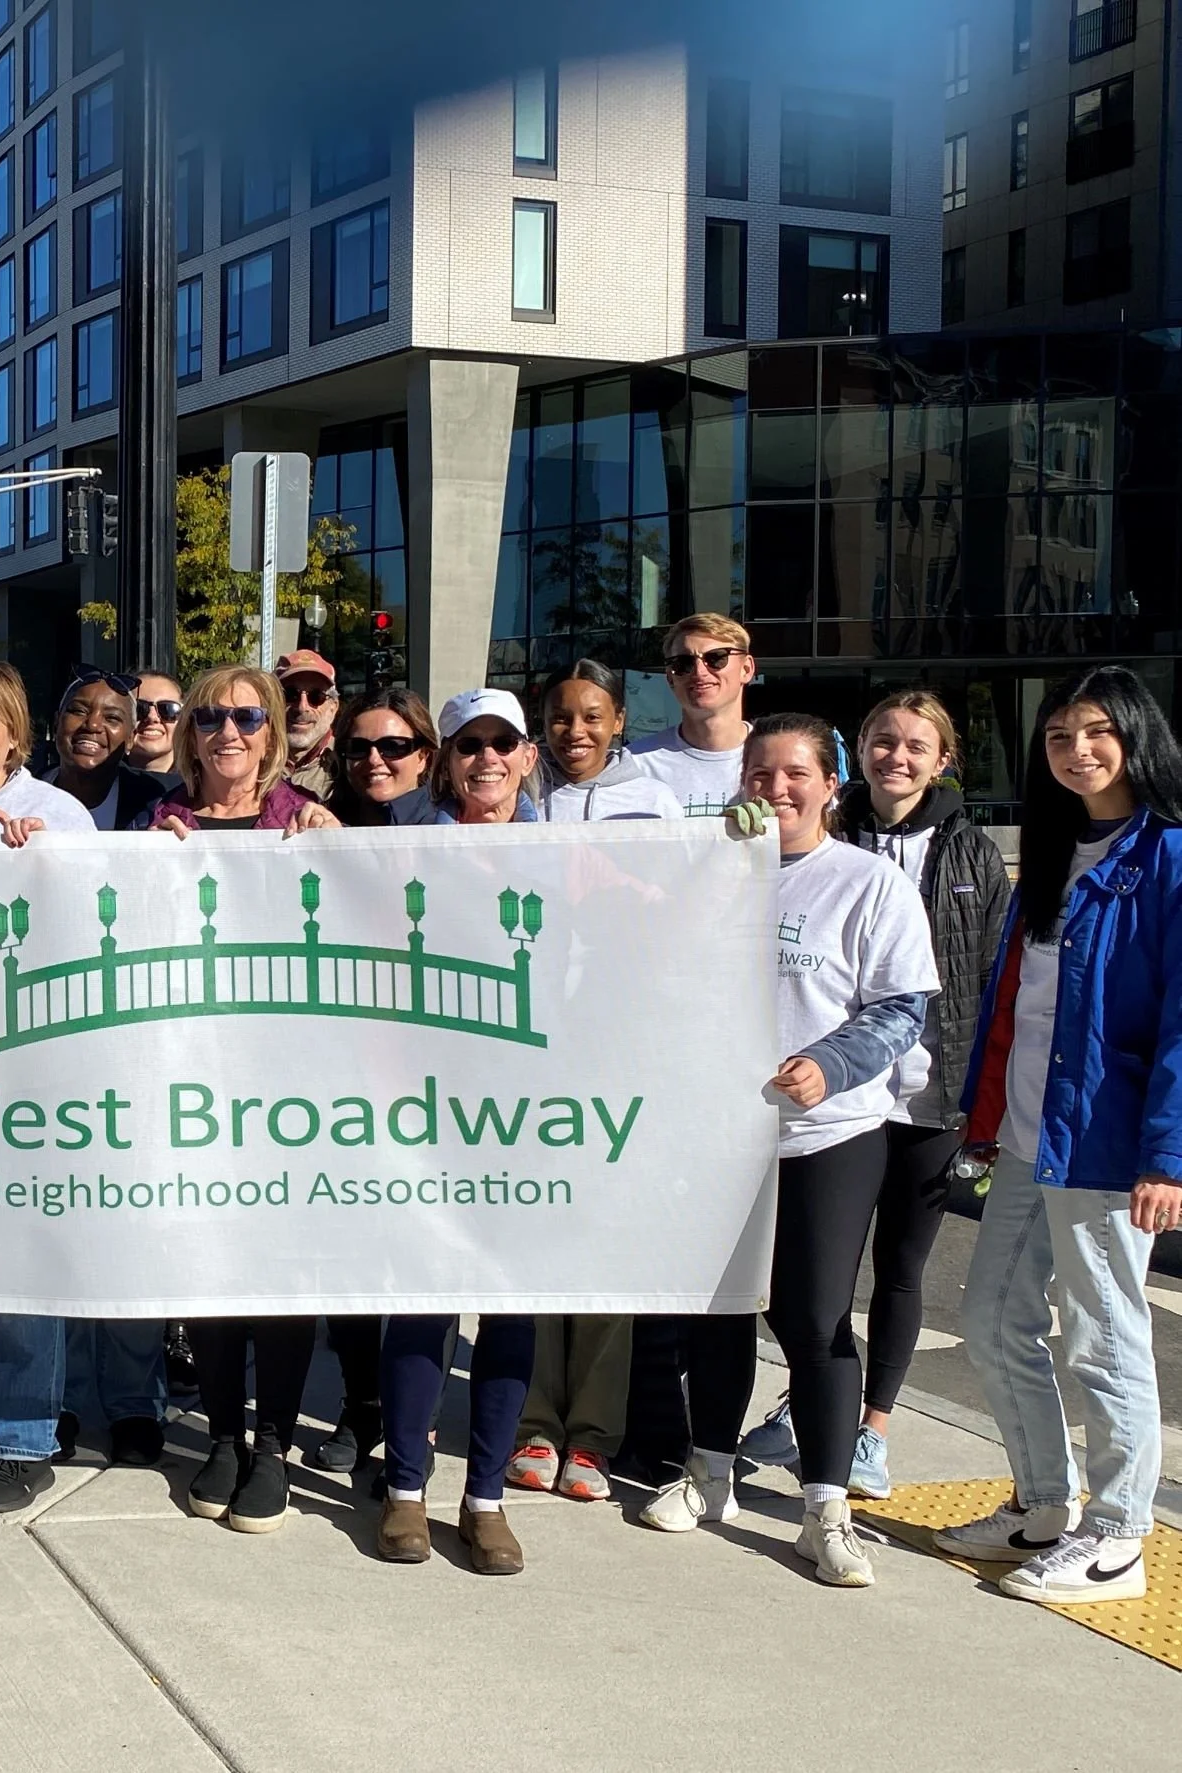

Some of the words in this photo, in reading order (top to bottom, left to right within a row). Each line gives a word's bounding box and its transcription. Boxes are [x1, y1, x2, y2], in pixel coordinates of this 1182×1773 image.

[778, 948, 825, 972] dway
[169, 1075, 644, 1164] Broadway
[307, 1170, 573, 1206] Association
